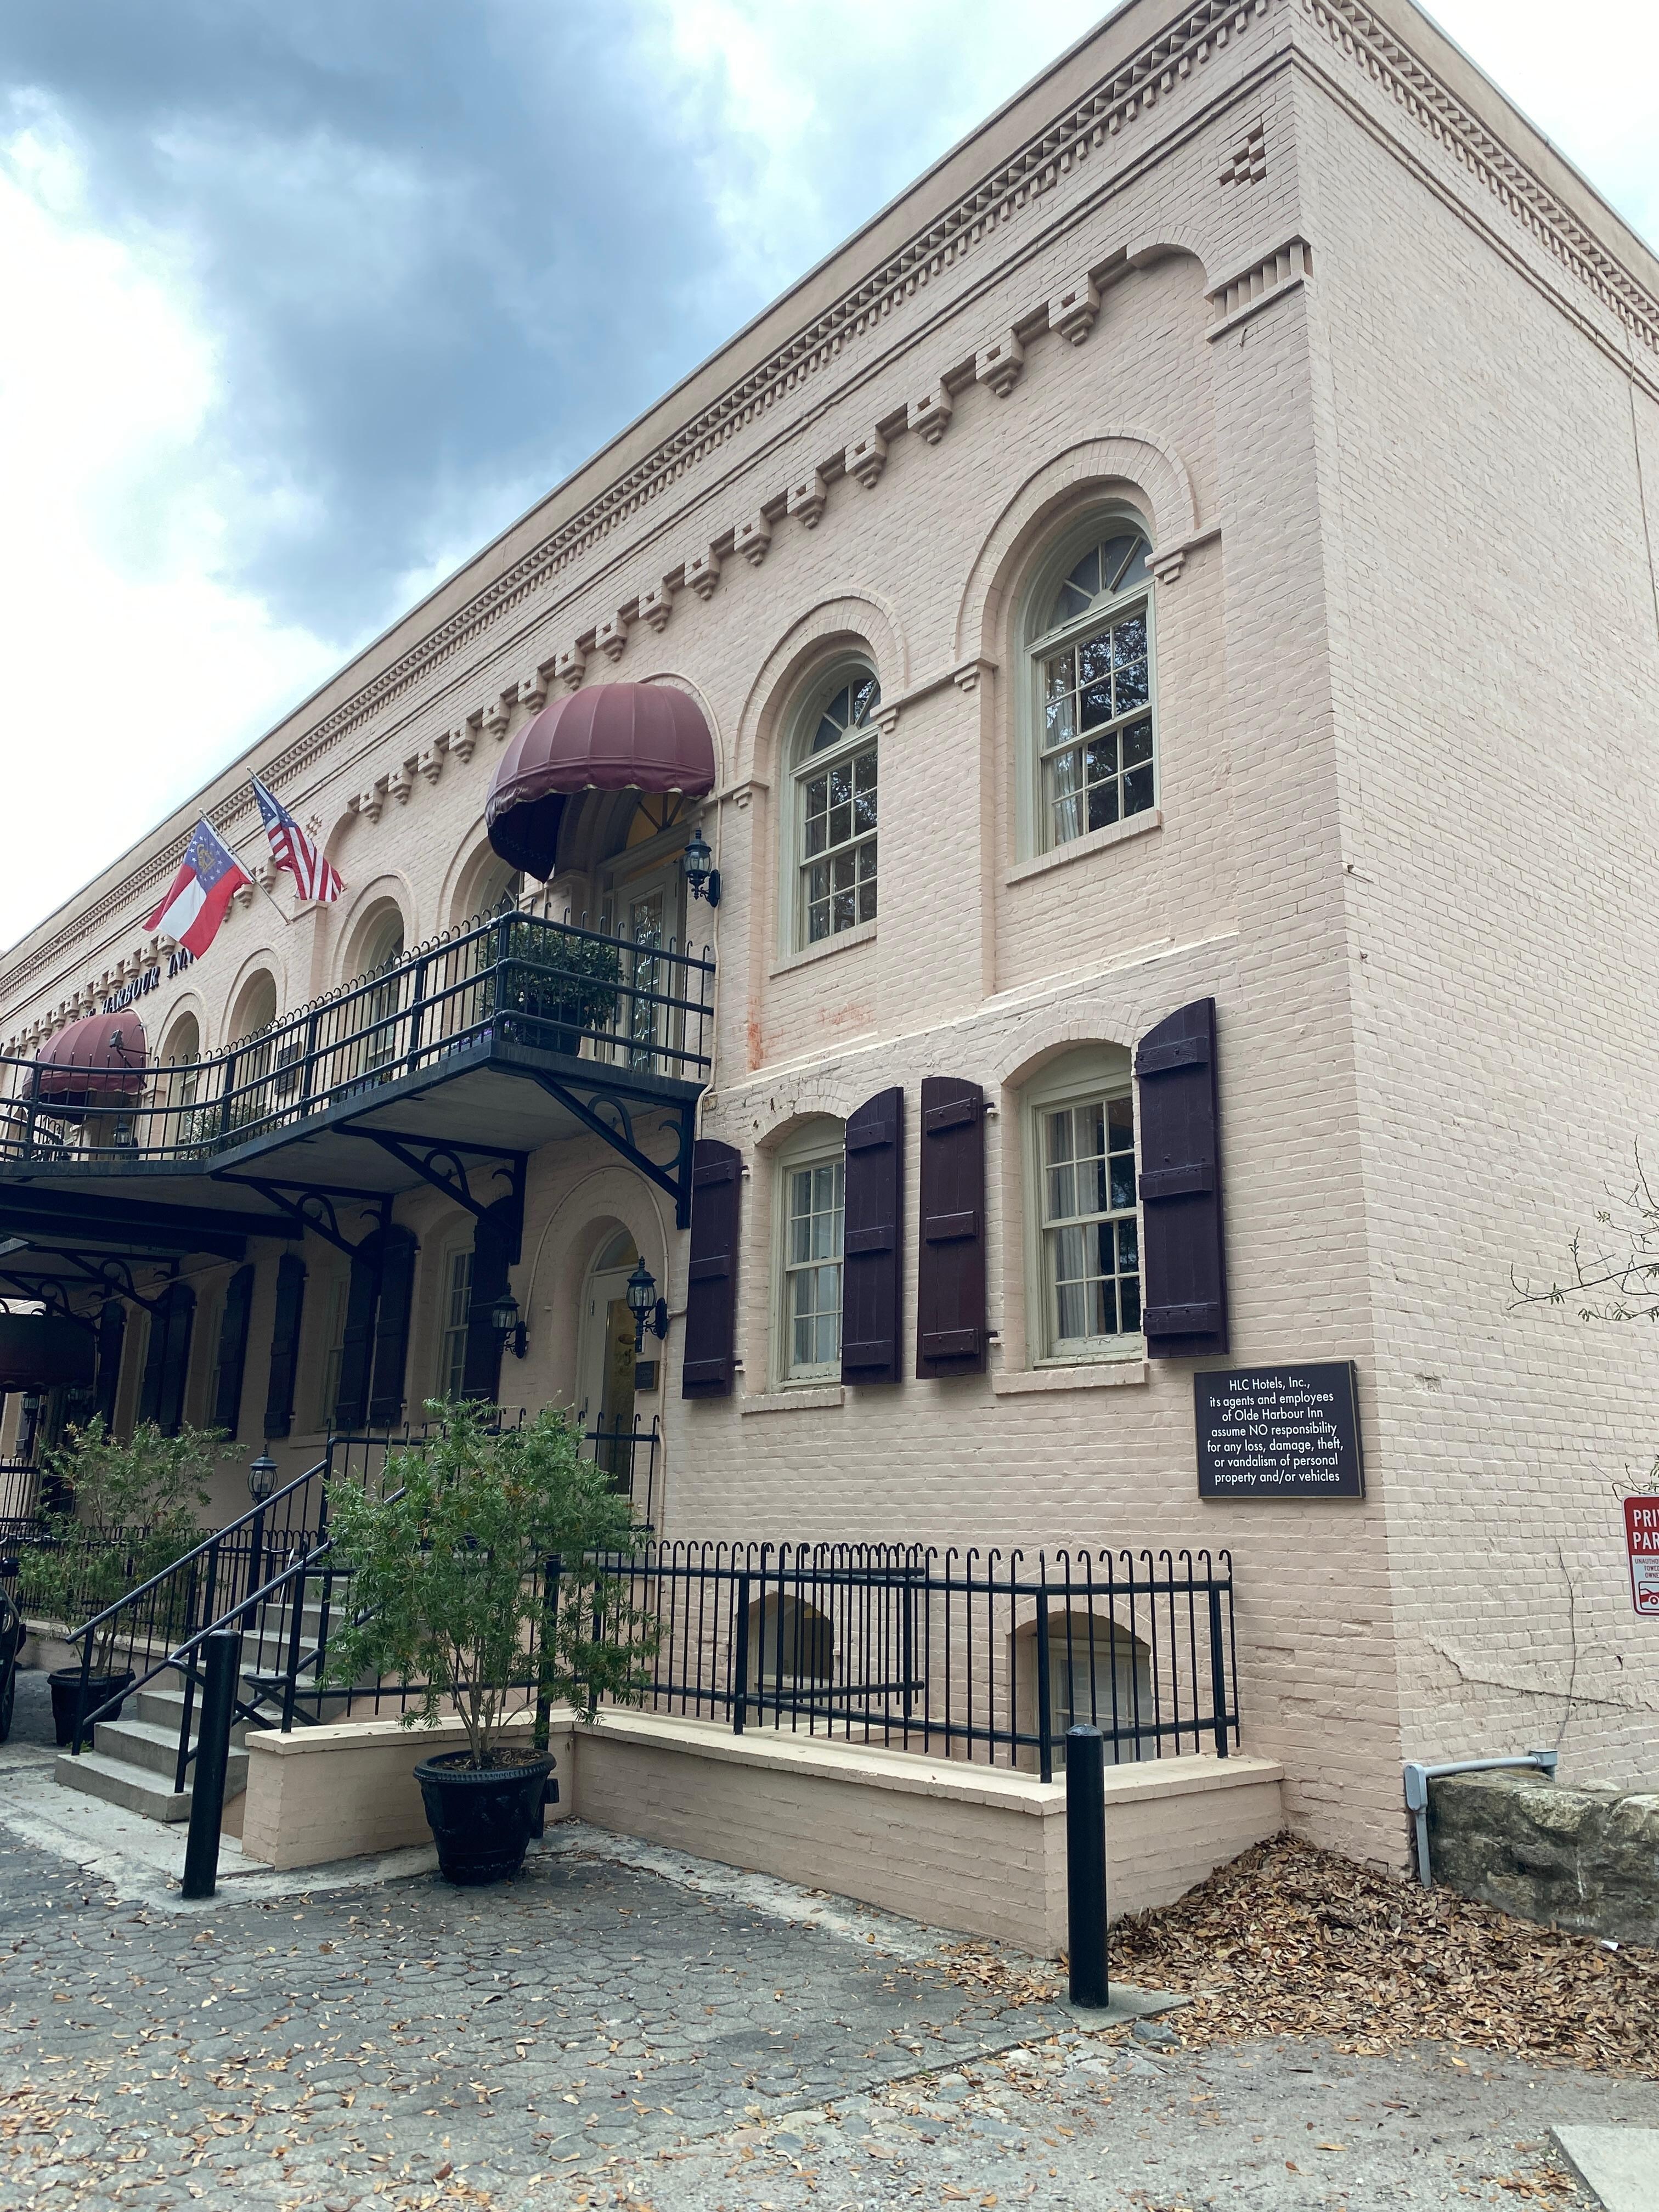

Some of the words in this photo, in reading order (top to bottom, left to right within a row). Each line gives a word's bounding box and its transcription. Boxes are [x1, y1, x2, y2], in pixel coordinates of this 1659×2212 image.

[102, 966, 161, 1014] HARBOUR
[167, 948, 194, 978] INN
[1229, 1379, 1249, 1391] HLC
[1252, 1376, 1285, 1390] Hotels,
[1289, 1376, 1310, 1389] Inc.,
[1210, 1396, 1221, 1407] its
[1223, 1395, 1255, 1409] agents
[1257, 1392, 1277, 1405] and
[1279, 1390, 1334, 1407] employees
[1222, 1409, 1232, 1421] of
[1234, 1408, 1259, 1421] Olde
[1262, 1407, 1305, 1420] Harbour
[1307, 1406, 1323, 1418] Inn
[1211, 1428, 1246, 1437] assume
[1249, 1424, 1268, 1436] NO
[1271, 1420, 1337, 1438] responsibility
[1207, 1440, 1221, 1452] for
[1223, 1444, 1242, 1455] any
[1244, 1439, 1266, 1453] loss,
[1269, 1438, 1314, 1453] damage,
[1317, 1436, 1344, 1451] theft,
[1214, 1459, 1225, 1468] or
[1227, 1454, 1277, 1467] vandalism
[1279, 1453, 1291, 1466] of
[1293, 1452, 1338, 1470] personal
[1215, 1472, 1257, 1486] property
[1260, 1469, 1296, 1485] and/or
[1298, 1468, 1340, 1482] vehicles
[1633, 1509, 1659, 1527] PRI
